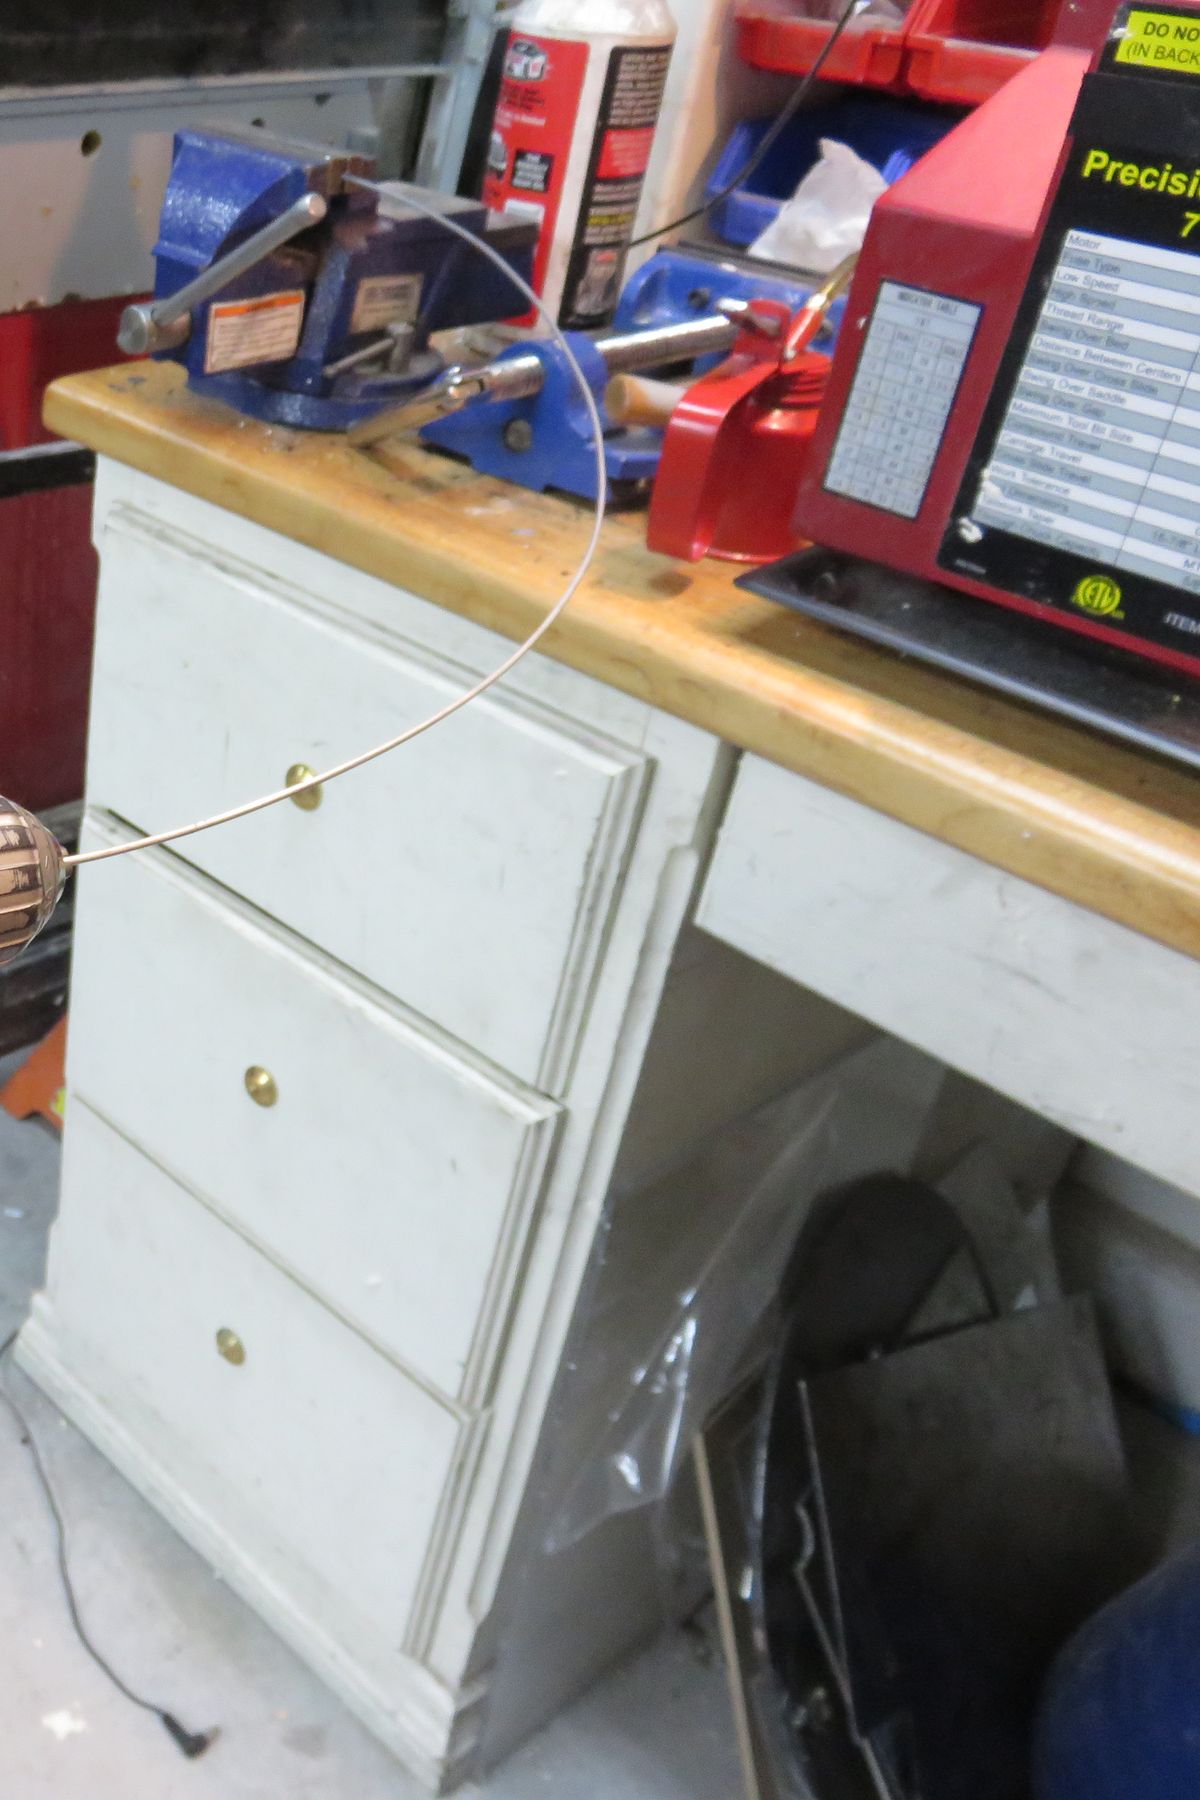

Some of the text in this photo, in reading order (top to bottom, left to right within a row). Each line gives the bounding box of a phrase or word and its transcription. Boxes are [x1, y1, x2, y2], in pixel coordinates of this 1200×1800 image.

[1143, 21, 1170, 37] DO
[1126, 41, 1152, 60] (IN
[1082, 148, 1200, 201] Precisi
